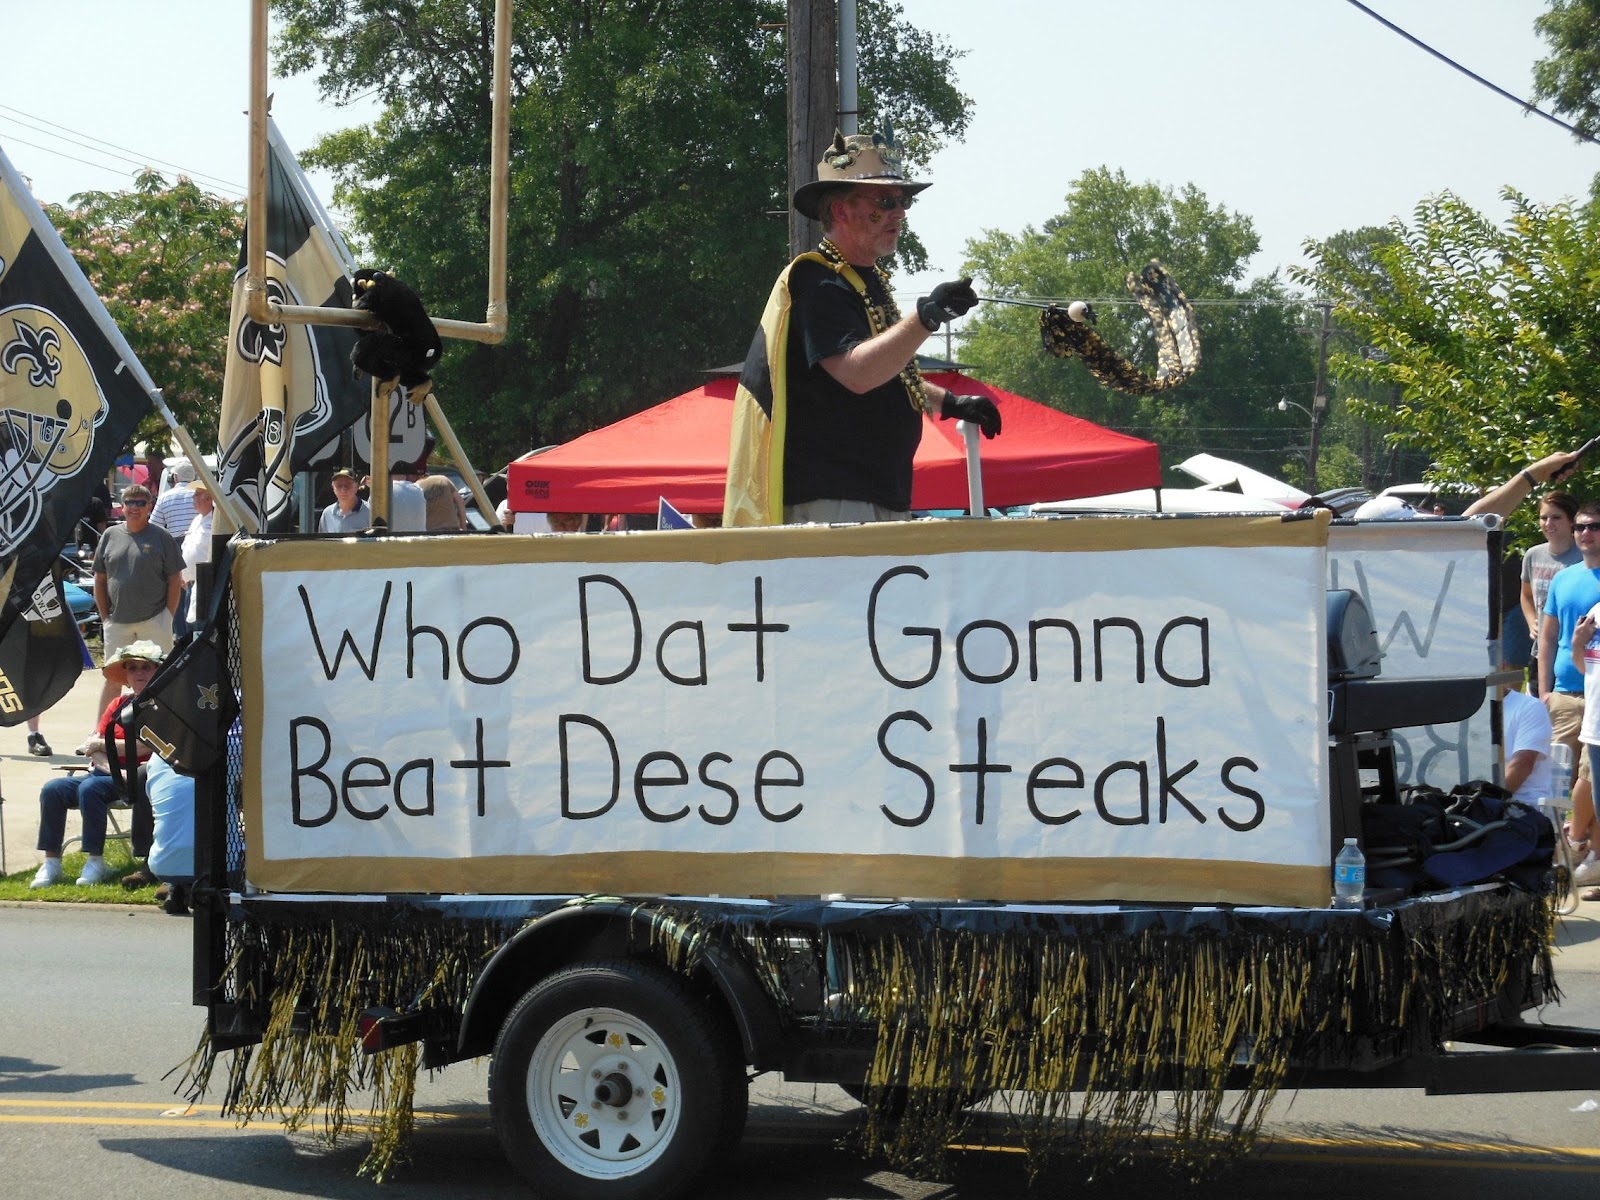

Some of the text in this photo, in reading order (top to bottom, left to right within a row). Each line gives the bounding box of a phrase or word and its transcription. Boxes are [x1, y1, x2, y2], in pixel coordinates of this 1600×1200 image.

[297, 565, 1211, 690] Who Dat Gonna
[289, 710, 1265, 832] Beat Dese Steaks
